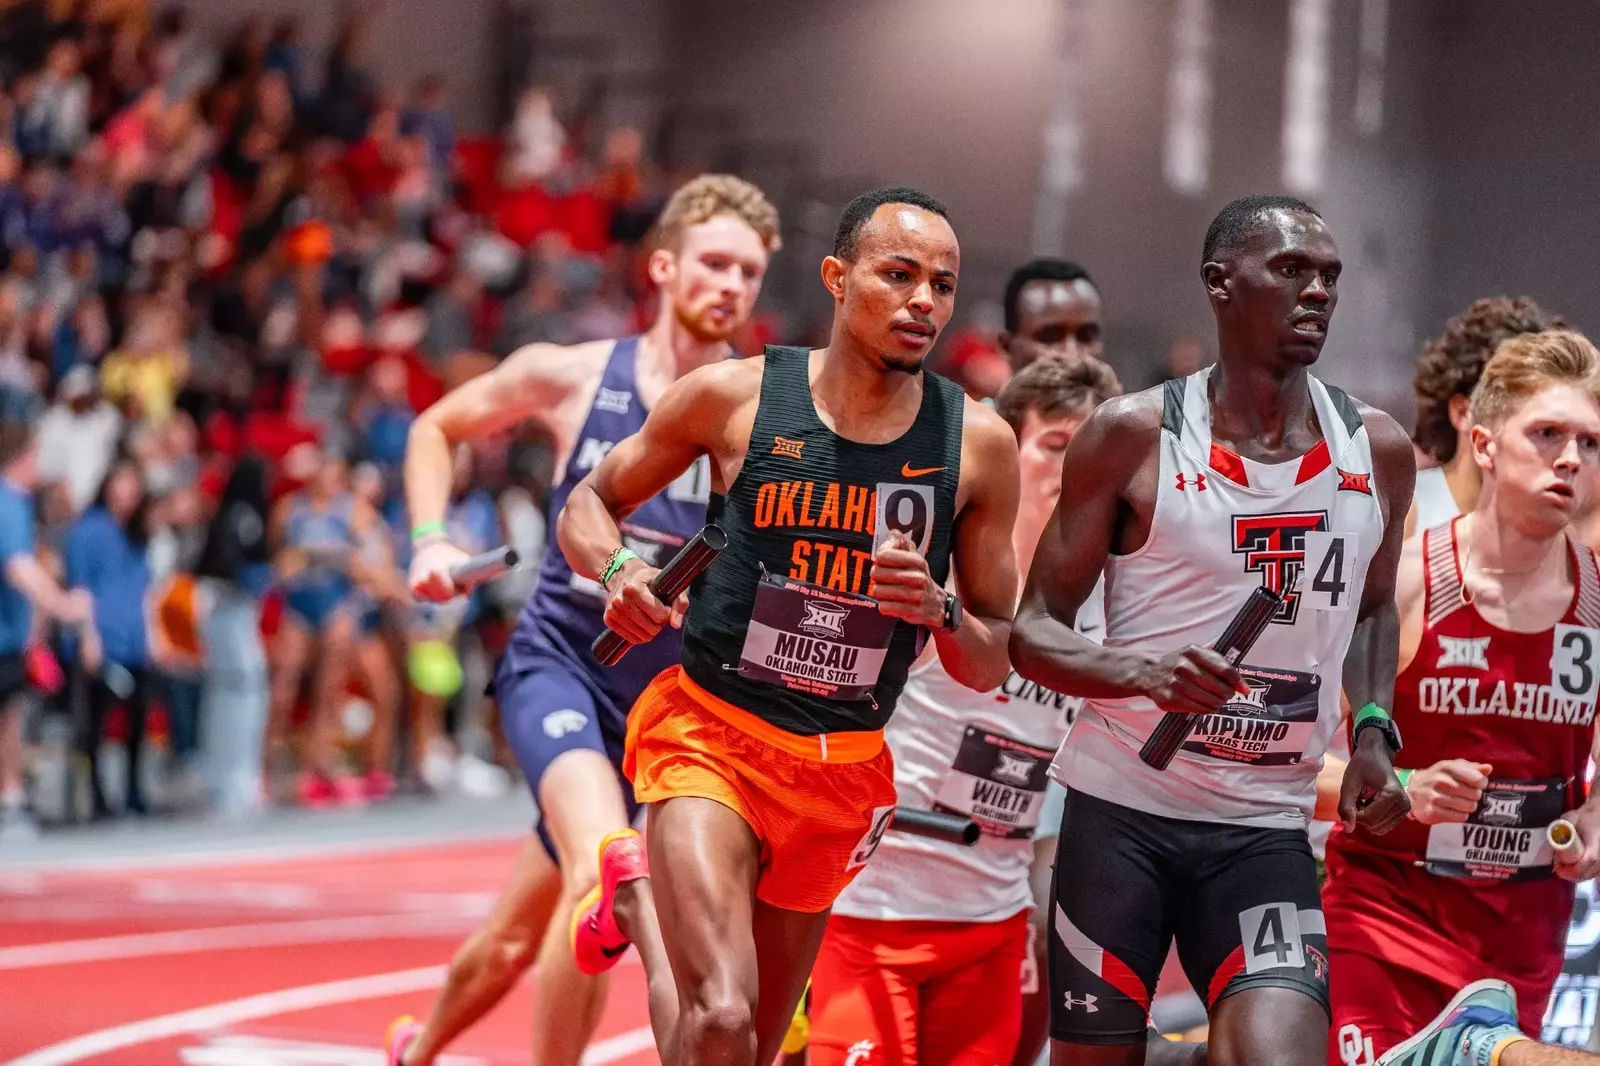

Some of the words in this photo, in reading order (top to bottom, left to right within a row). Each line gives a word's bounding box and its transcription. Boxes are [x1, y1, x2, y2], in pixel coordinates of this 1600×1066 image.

[885, 489, 927, 551] 9
[1311, 537, 1346, 607] 4
[774, 632, 859, 671] MUSAU
[1559, 631, 1593, 695] 3
[765, 655, 825, 680] OKLAHOMA
[827, 669, 858, 684] STATE
[1194, 714, 1290, 742] KIPLIMO
[1205, 735, 1240, 748] TEXAS
[1241, 742, 1269, 752] TECH
[972, 779, 1033, 813] WIRTH
[1462, 825, 1532, 853] YOUNG
[1465, 848, 1521, 865] OKLAHOMA
[1253, 907, 1293, 963] 4
